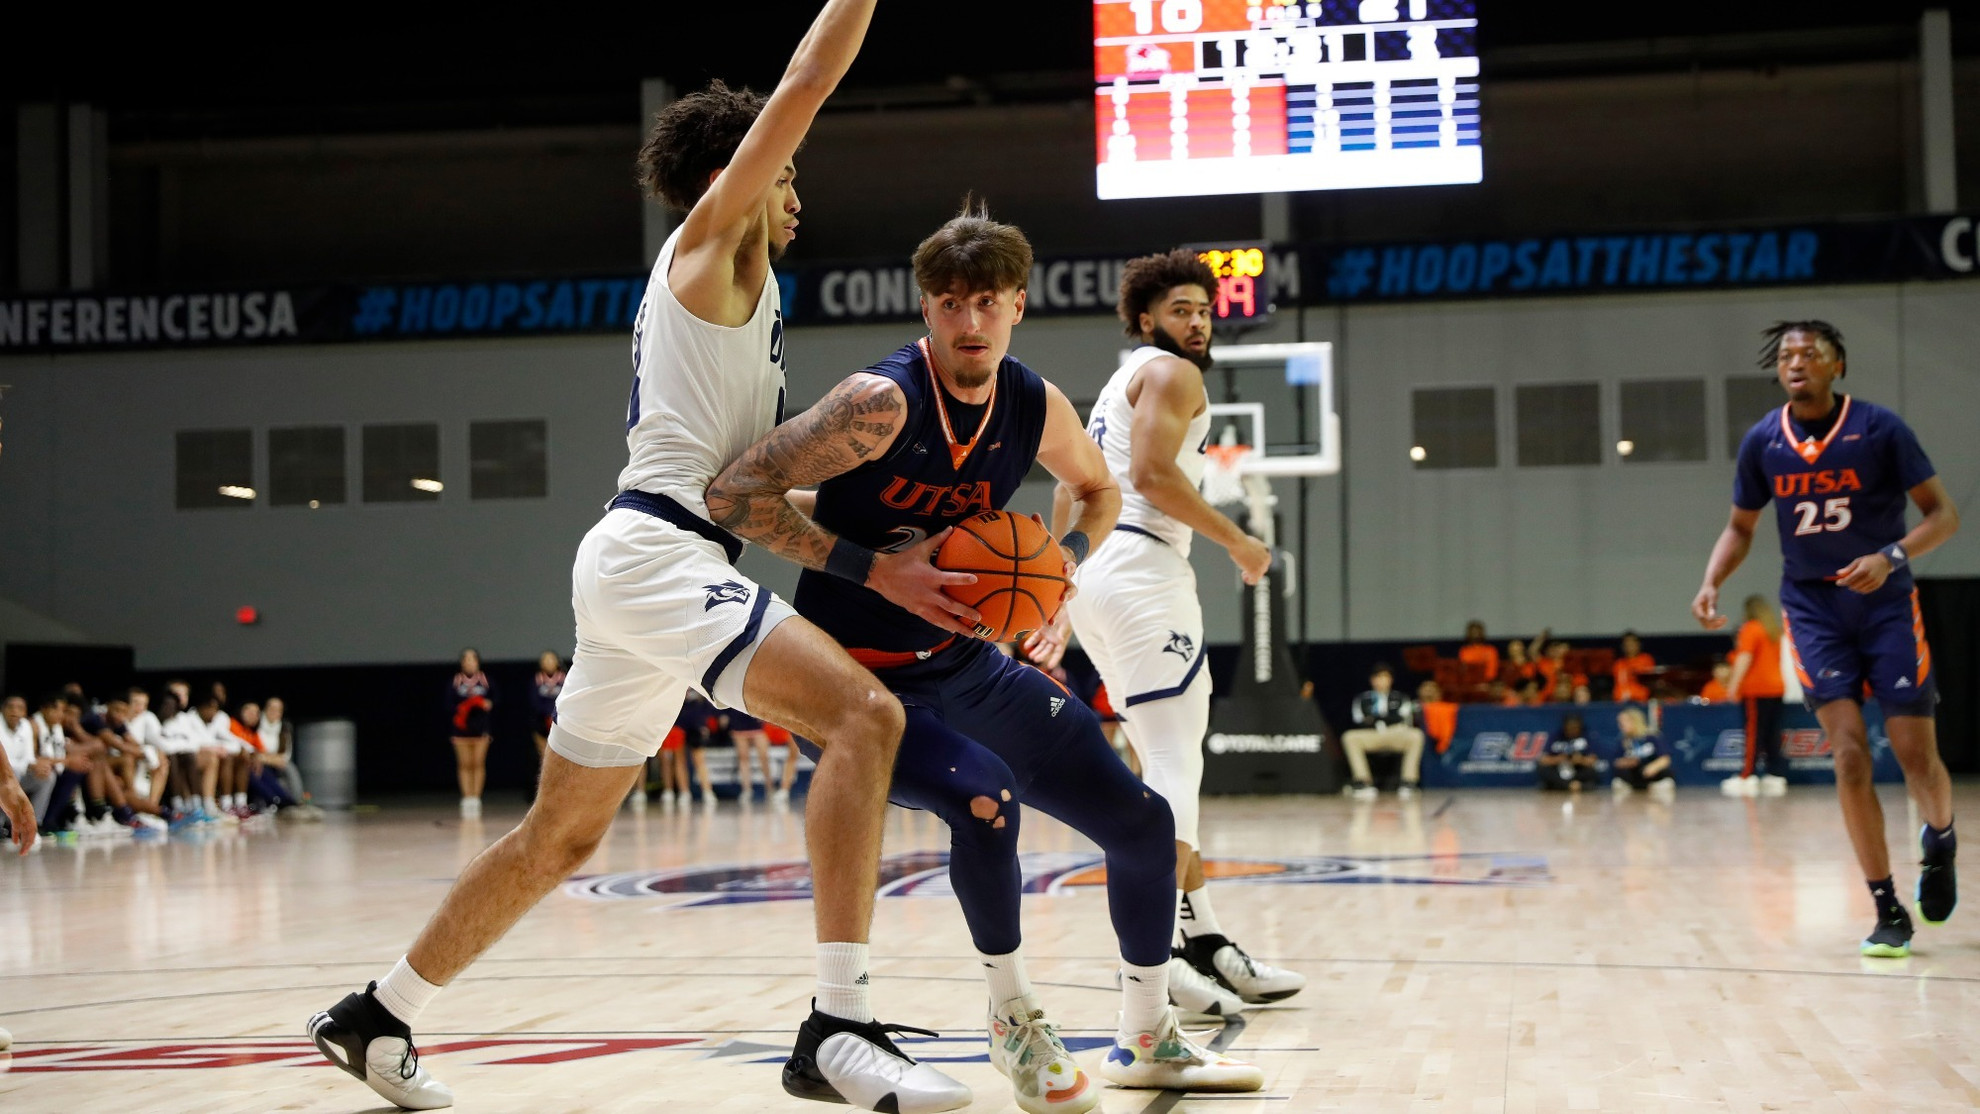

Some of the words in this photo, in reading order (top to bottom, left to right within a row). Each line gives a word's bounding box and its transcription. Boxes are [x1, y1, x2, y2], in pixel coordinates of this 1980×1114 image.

[1328, 230, 1818, 298] #HOOPSATTHESTAR
[1940, 216, 1980, 273] C
[879, 475, 993, 517] UTSA
[1774, 468, 1862, 498] UTSA
[1794, 497, 1852, 536] 25
